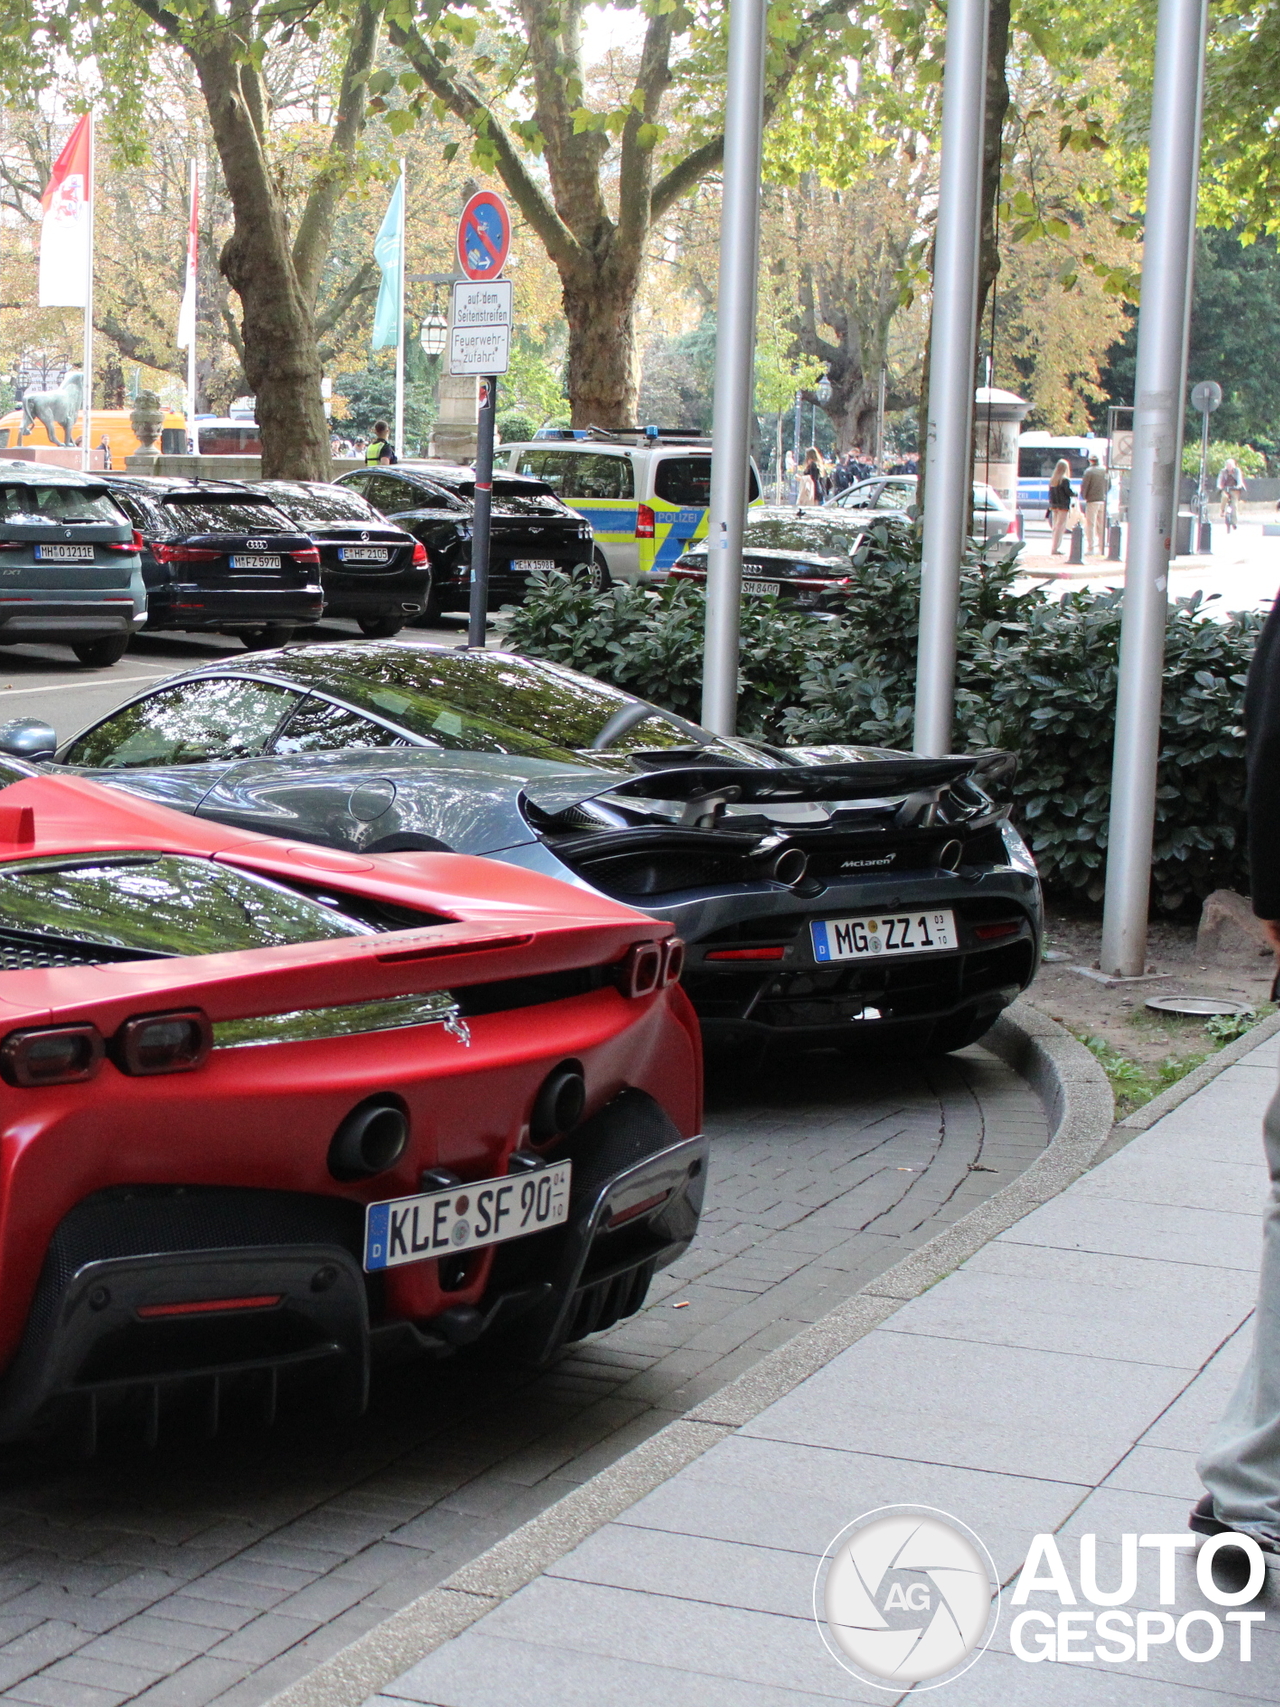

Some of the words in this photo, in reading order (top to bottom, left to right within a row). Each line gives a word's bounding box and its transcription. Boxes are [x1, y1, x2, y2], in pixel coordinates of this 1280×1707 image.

[467, 292, 480, 304] auf
[482, 291, 498, 304] dem
[458, 308, 508, 322] Seitenstreifen
[455, 333, 505, 347] Feuerwehr-
[463, 351, 495, 363] zufahrt
[657, 513, 698, 523] POLIZEI
[41, 547, 53, 557] MH
[67, 547, 93, 557] 1211E
[343, 549, 349, 558] E
[355, 549, 365, 558] HF
[367, 549, 388, 558] 2105
[234, 557, 240, 567] M
[246, 557, 258, 567] FZ
[260, 557, 280, 567] 5970
[743, 582, 755, 593] SH
[840, 856, 891, 868] McLaren
[934, 915, 943, 924] 03
[834, 922, 869, 954] MG
[882, 918, 914, 949] ZZ
[918, 916, 933, 946] 1
[938, 935, 947, 945] 10
[553, 1172, 565, 1186] 04
[390, 1199, 450, 1257] KLE
[475, 1185, 513, 1238] SF
[520, 1176, 551, 1227] 90
[552, 1203, 563, 1218] 10
[372, 1244, 381, 1258] D
